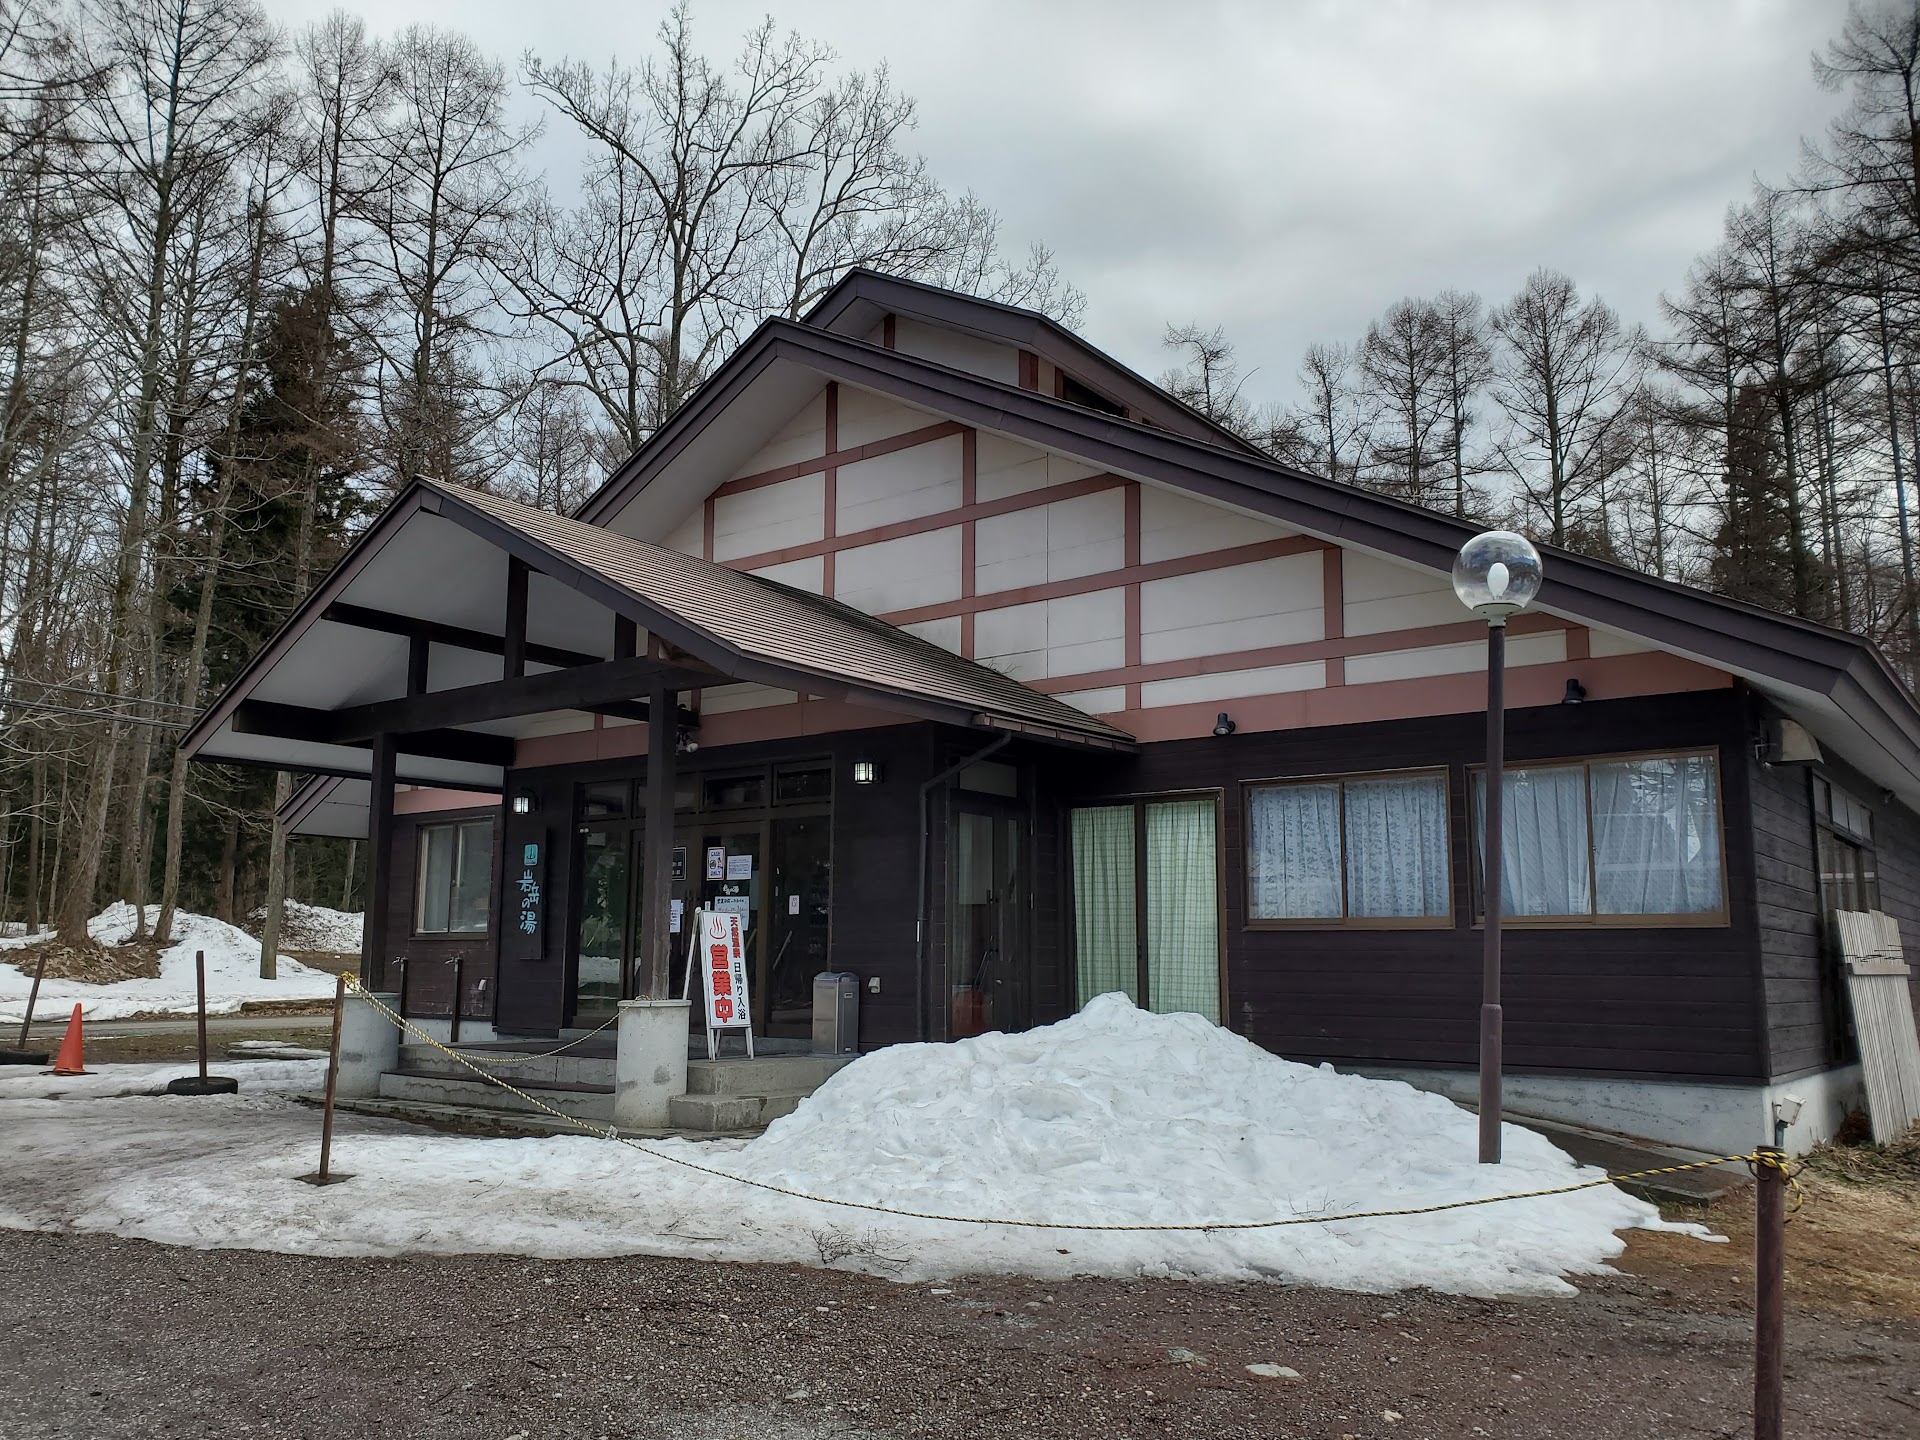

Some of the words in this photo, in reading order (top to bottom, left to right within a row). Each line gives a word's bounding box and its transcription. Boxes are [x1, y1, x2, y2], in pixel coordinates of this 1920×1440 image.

[515, 869, 540, 934] 岩岳の湯
[710, 943, 733, 1023] 営業中
[734, 962, 746, 1020] 日帰り入浴
